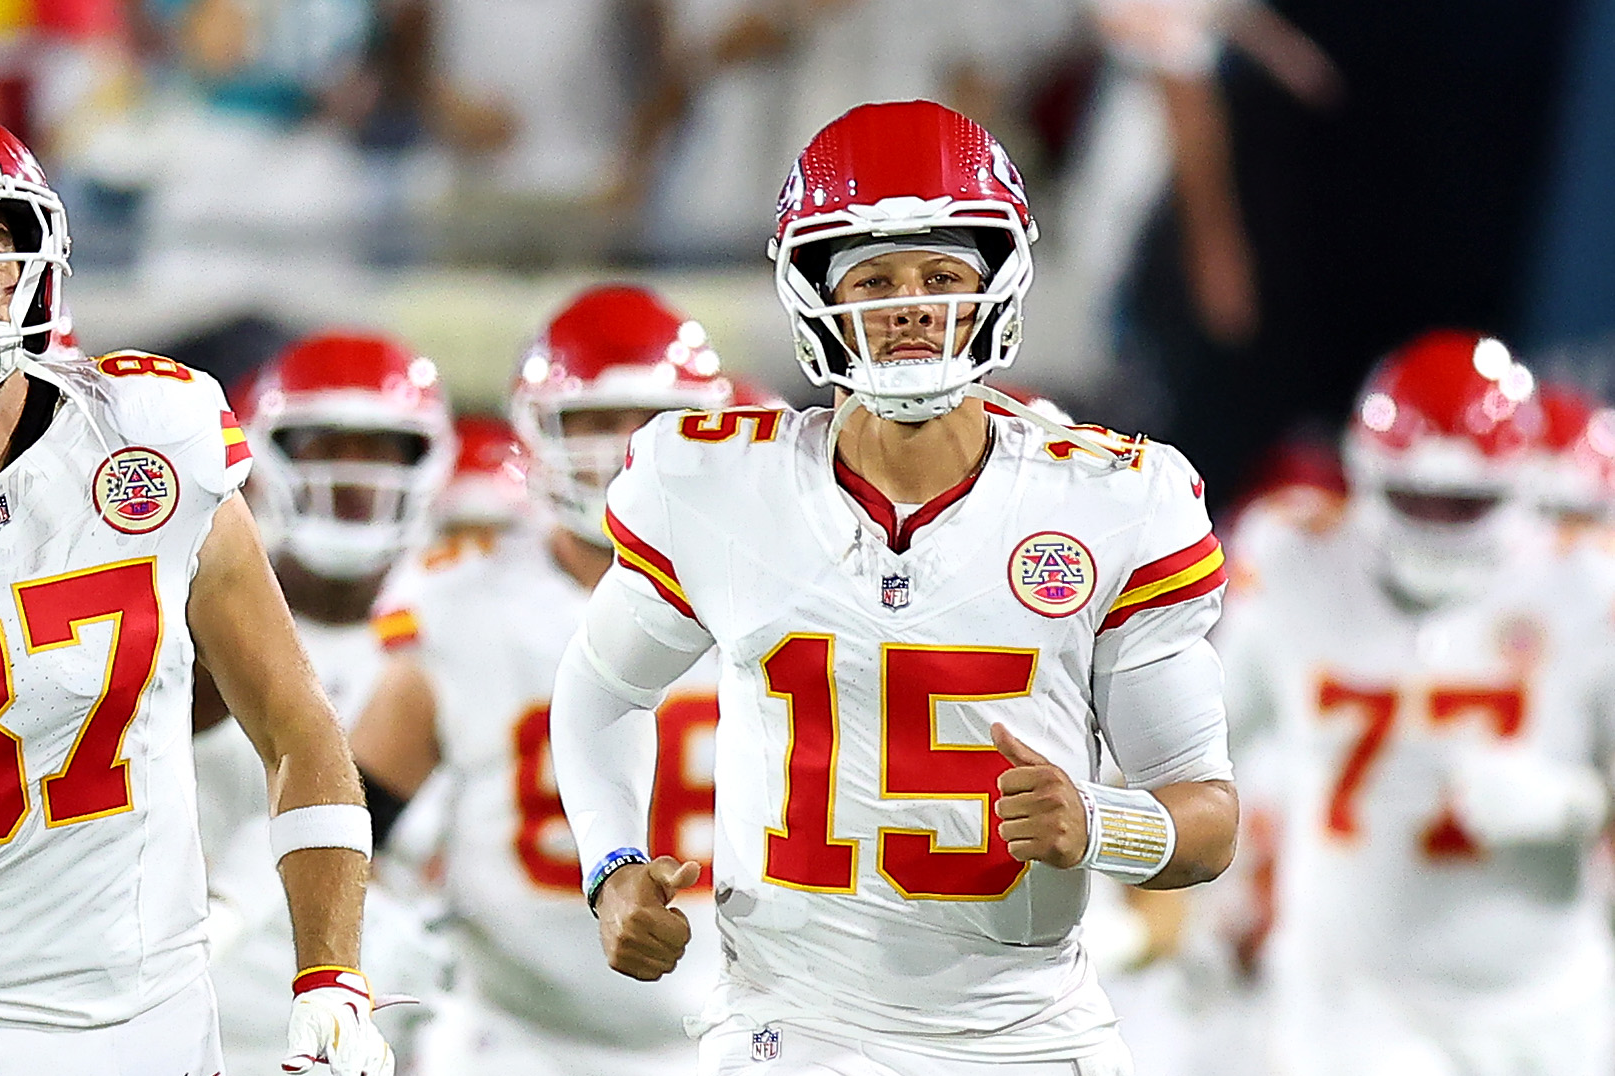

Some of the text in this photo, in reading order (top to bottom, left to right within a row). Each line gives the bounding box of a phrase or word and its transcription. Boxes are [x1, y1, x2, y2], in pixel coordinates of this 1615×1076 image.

[678, 405, 782, 444] 5
[760, 632, 1040, 900] 15
[1316, 674, 1526, 860] 77
